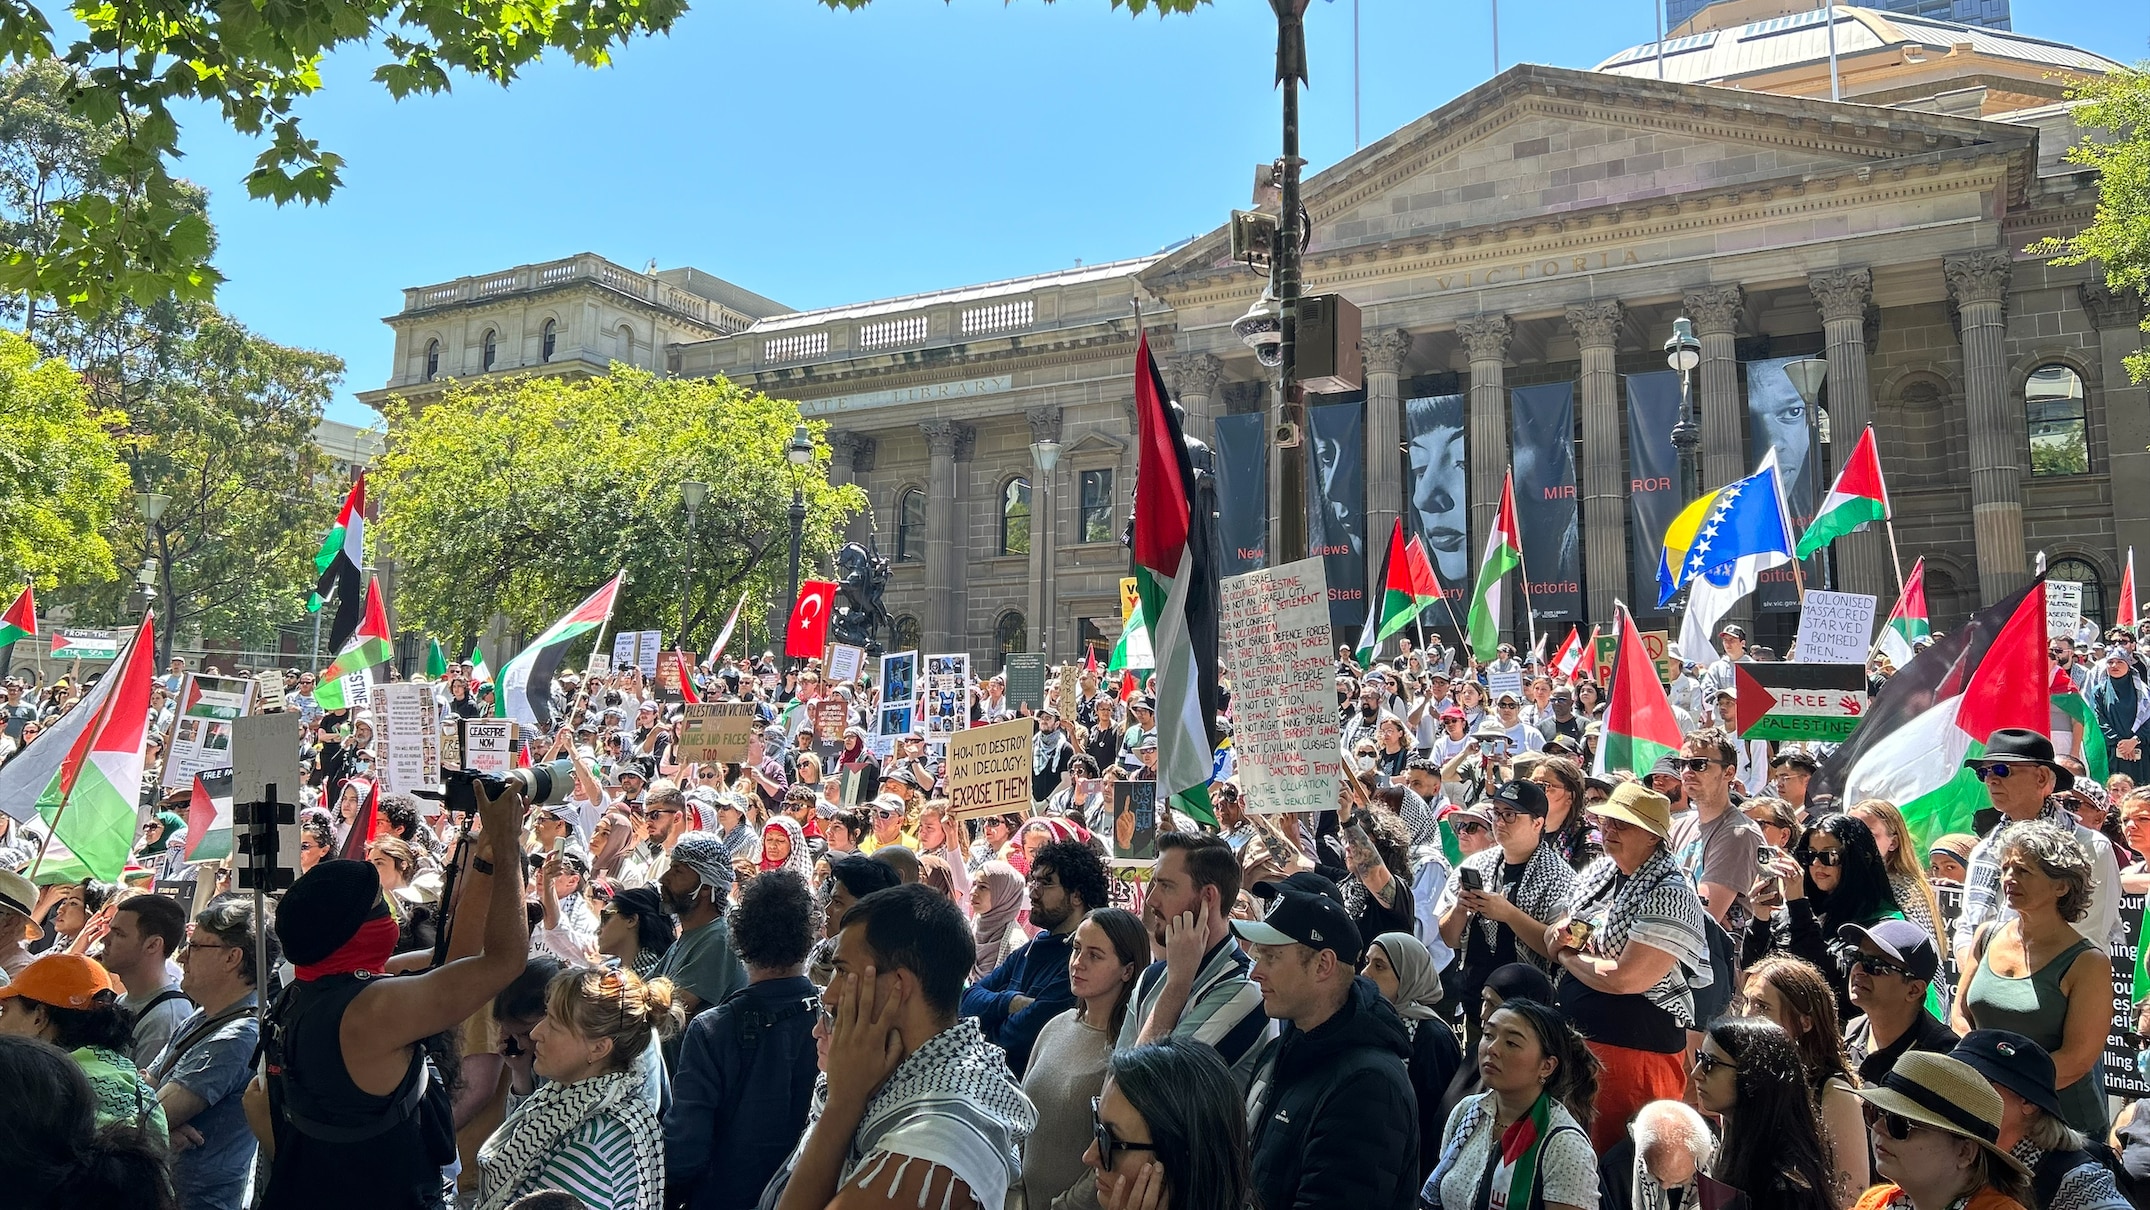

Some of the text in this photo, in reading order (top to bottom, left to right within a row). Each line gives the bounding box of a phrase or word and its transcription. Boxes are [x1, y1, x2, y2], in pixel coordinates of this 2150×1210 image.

[1436, 249, 1640, 290] VICTORIA
[893, 377, 1006, 402] LIBRARY
[1544, 477, 1672, 500] MIR ROR
[1237, 544, 1349, 560] New views
[1230, 587, 1257, 600] OCCUPIED
[1260, 575, 1302, 592] PALESTINE
[1232, 579, 1246, 590] NOT
[1249, 573, 1276, 586] ISRAEL
[1328, 588, 1362, 600] State
[1520, 580, 1578, 595] Victoria
[1232, 598, 1245, 609] NOT
[1247, 597, 1256, 606] AN
[1259, 591, 1285, 603] ISRAELI
[1289, 585, 1307, 597] CITY
[1234, 610, 1242, 619] AN
[1245, 604, 1271, 617] ILLEGAL
[1276, 592, 1320, 611] SETTLEMENT
[1808, 592, 1873, 609] COLONISED
[1233, 620, 1244, 629] NOT
[1245, 613, 1277, 626] CONFLICT
[1802, 605, 1869, 622] MASSACRED
[63, 629, 110, 638] FROM THE
[1236, 622, 1278, 638] OCCUPATION
[1804, 617, 1863, 634] STARVED
[1234, 637, 1247, 648] NOT
[1273, 629, 1302, 643] DEFENCE
[1306, 624, 1331, 636] FORCES
[1261, 641, 1298, 654] OCCUPATION
[1301, 635, 1330, 648] FORCES
[1811, 631, 1859, 647] BOMBED
[1240, 658, 1253, 669] NOT
[1256, 651, 1299, 665] TERRORISM
[1804, 643, 1849, 660] THEN...
[1241, 664, 1286, 680] PALESTINIAN
[1242, 679, 1257, 691] NOT
[1260, 673, 1288, 687] ISRAELI
[1293, 667, 1326, 680] PEOPLE
[1245, 687, 1275, 699] ILLEGAL
[1279, 679, 1324, 695] SETTLERS
[1245, 694, 1304, 711] NOT EVICTION
[1781, 694, 1828, 707] FREE
[685, 704, 756, 718] PALESTINIAN VICTIMS
[1248, 711, 1271, 721] ETHNIC
[1276, 701, 1324, 718] CLEANSING
[1245, 723, 1258, 733] NOT
[1260, 720, 1280, 731] RIGHT
[1305, 711, 1337, 726] ISRAELIS
[1763, 717, 1852, 733] PALESTINE
[469, 727, 506, 737] CEASEFIRE
[681, 733, 747, 746] NAMES AND FACES
[1282, 726, 1314, 739] TERRORIST
[1317, 723, 1340, 736] GANGS
[479, 738, 495, 748] NOW
[953, 734, 1028, 761] HOW TO DESTROY
[1248, 744, 1259, 754] NOT
[1263, 740, 1296, 753] CIVILIAN
[1302, 737, 1336, 750] CLASHES
[702, 749, 718, 761] TOO
[1254, 752, 1306, 767] OCCUPATIONAL
[203, 769, 222, 780] FREE
[953, 755, 1026, 780] AN IDEOLOGY:
[1269, 763, 1309, 777] SANCTIONED
[952, 775, 1028, 809] EXPOSE THEM
[1240, 778, 1330, 798] END THE OCCUPATION
[1248, 799, 1265, 809] END
[1268, 797, 1281, 806] THE
[1284, 794, 1323, 806] GENOCIDE
